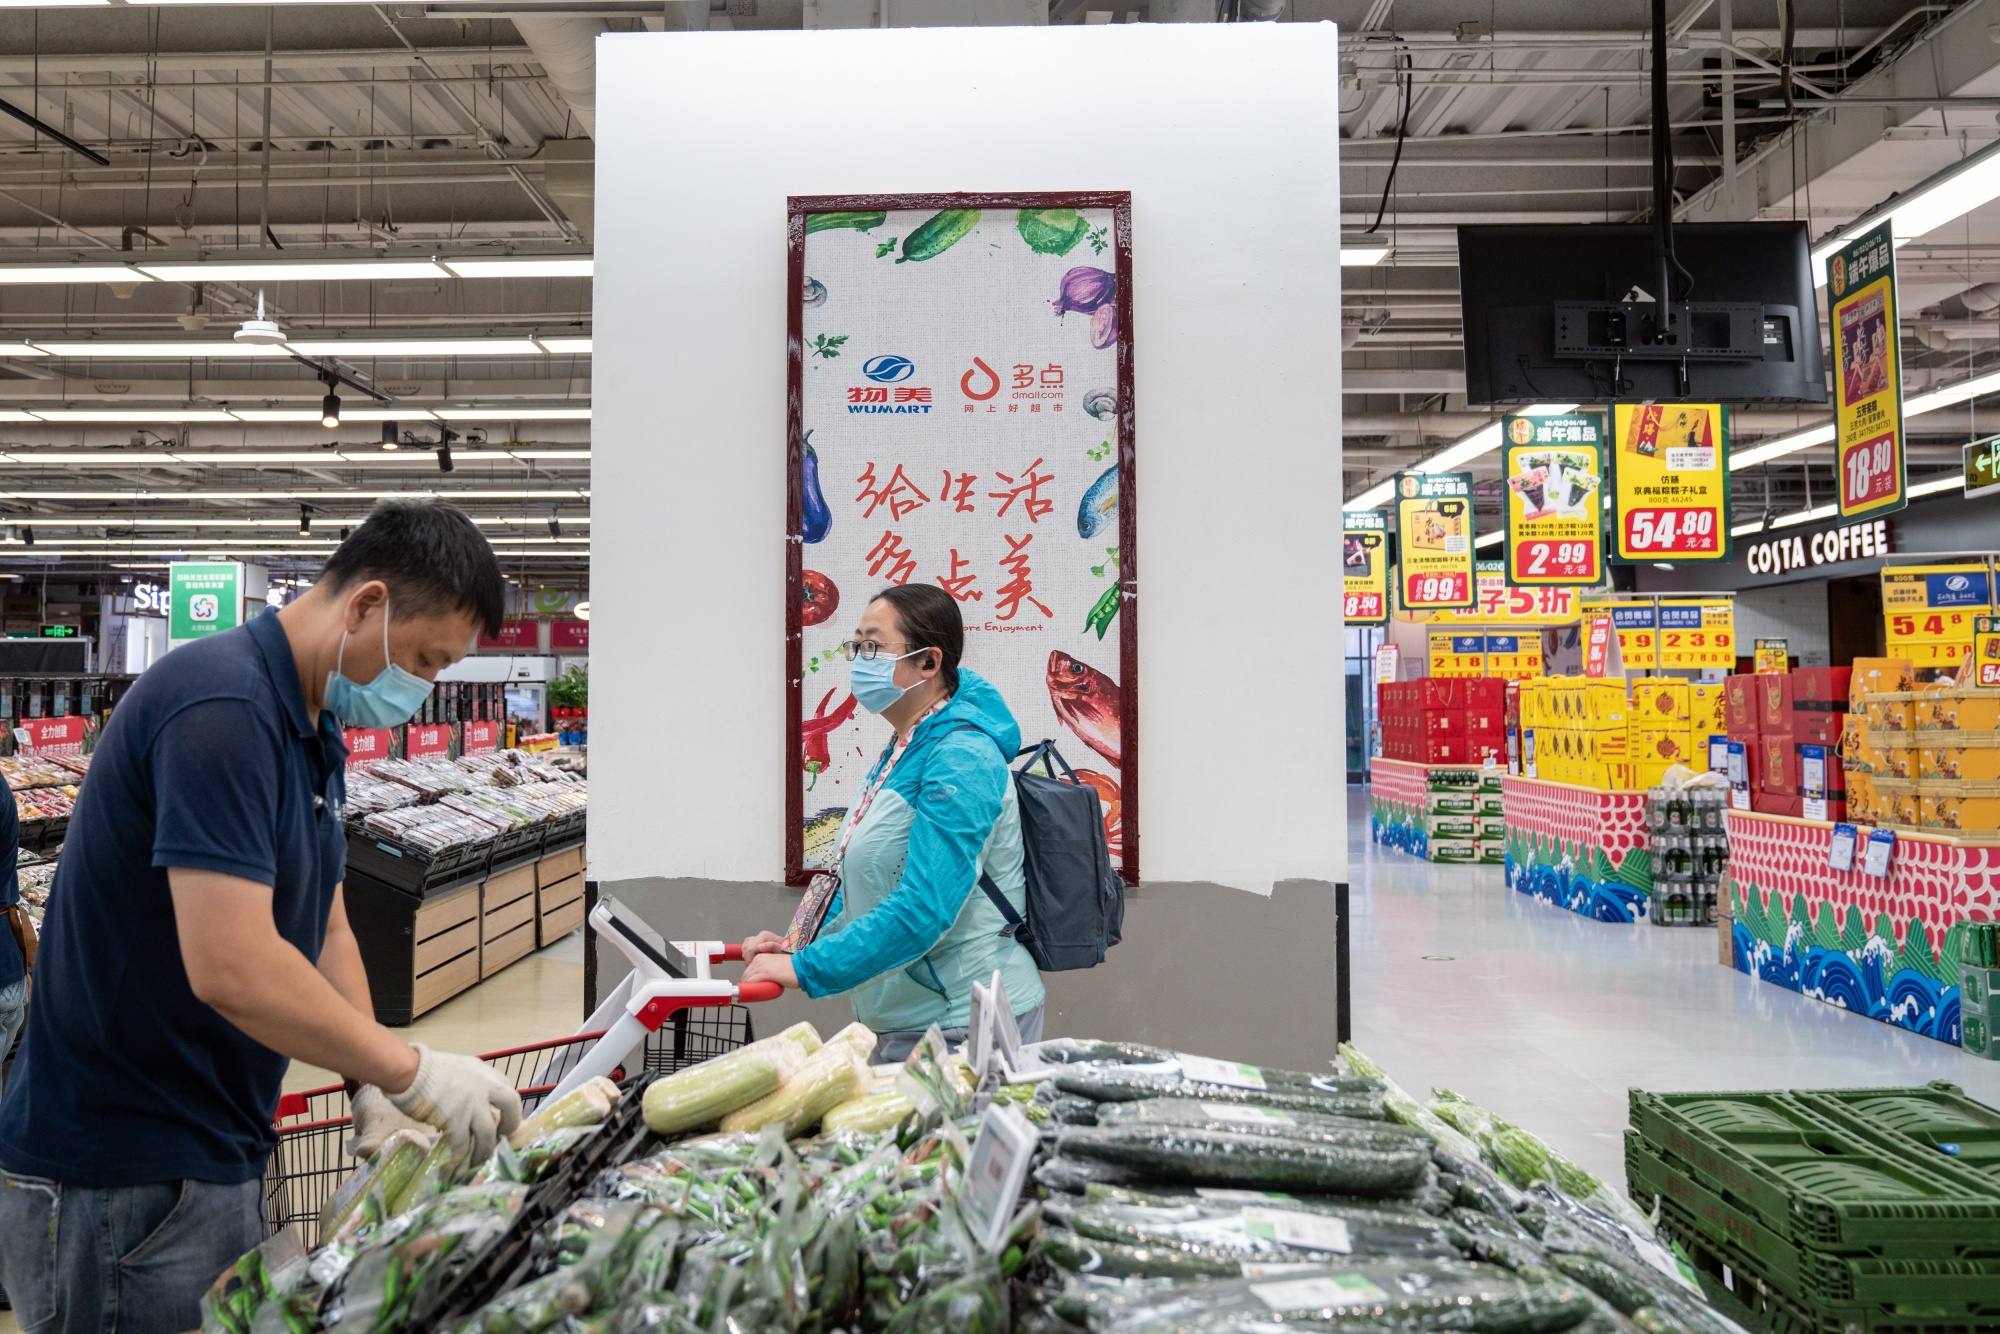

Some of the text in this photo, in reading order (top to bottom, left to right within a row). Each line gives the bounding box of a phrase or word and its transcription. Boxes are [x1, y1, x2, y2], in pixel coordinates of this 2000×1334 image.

[1848, 242, 1890, 286] 端午爆品
[1012, 363, 1064, 389] 多点
[847, 387, 932, 403] 物美
[1012, 391, 1063, 399] dmall.com
[847, 405, 932, 414] WUMART
[964, 404, 1063, 413] 网上好超市
[1536, 426, 1597, 442] 端午爆品
[1847, 439, 1891, 501] 18.80
[1661, 475, 1679, 484] 仿膳
[1875, 475, 1892, 493] 元/袋
[855, 457, 1055, 523] 给生活
[1421, 483, 1468, 496] 端午爆品
[1630, 511, 1713, 549] 54.80
[1686, 537, 1711, 548] 元/盒
[1747, 519, 1888, 575] COSTA COFFEE
[1527, 542, 1586, 575] 2.99
[865, 530, 1054, 620] 多点美
[1563, 564, 1587, 575] 元/袋
[1423, 578, 1454, 601] 99
[1345, 597, 1377, 616] 8.50
[1615, 610, 1652, 620] 会员商品
[1662, 610, 1699, 620] 会员商品
[984, 622, 1044, 633] Enjoyment
[1666, 633, 1730, 648] 239
[1434, 657, 1480, 668] 218
[1493, 656, 1538, 667] 118
[41, 725, 67, 739] 全力创建
[420, 730, 438, 746] 全力创建
[473, 727, 489, 741] 全力创建
[353, 735, 376, 752] 全力创建
